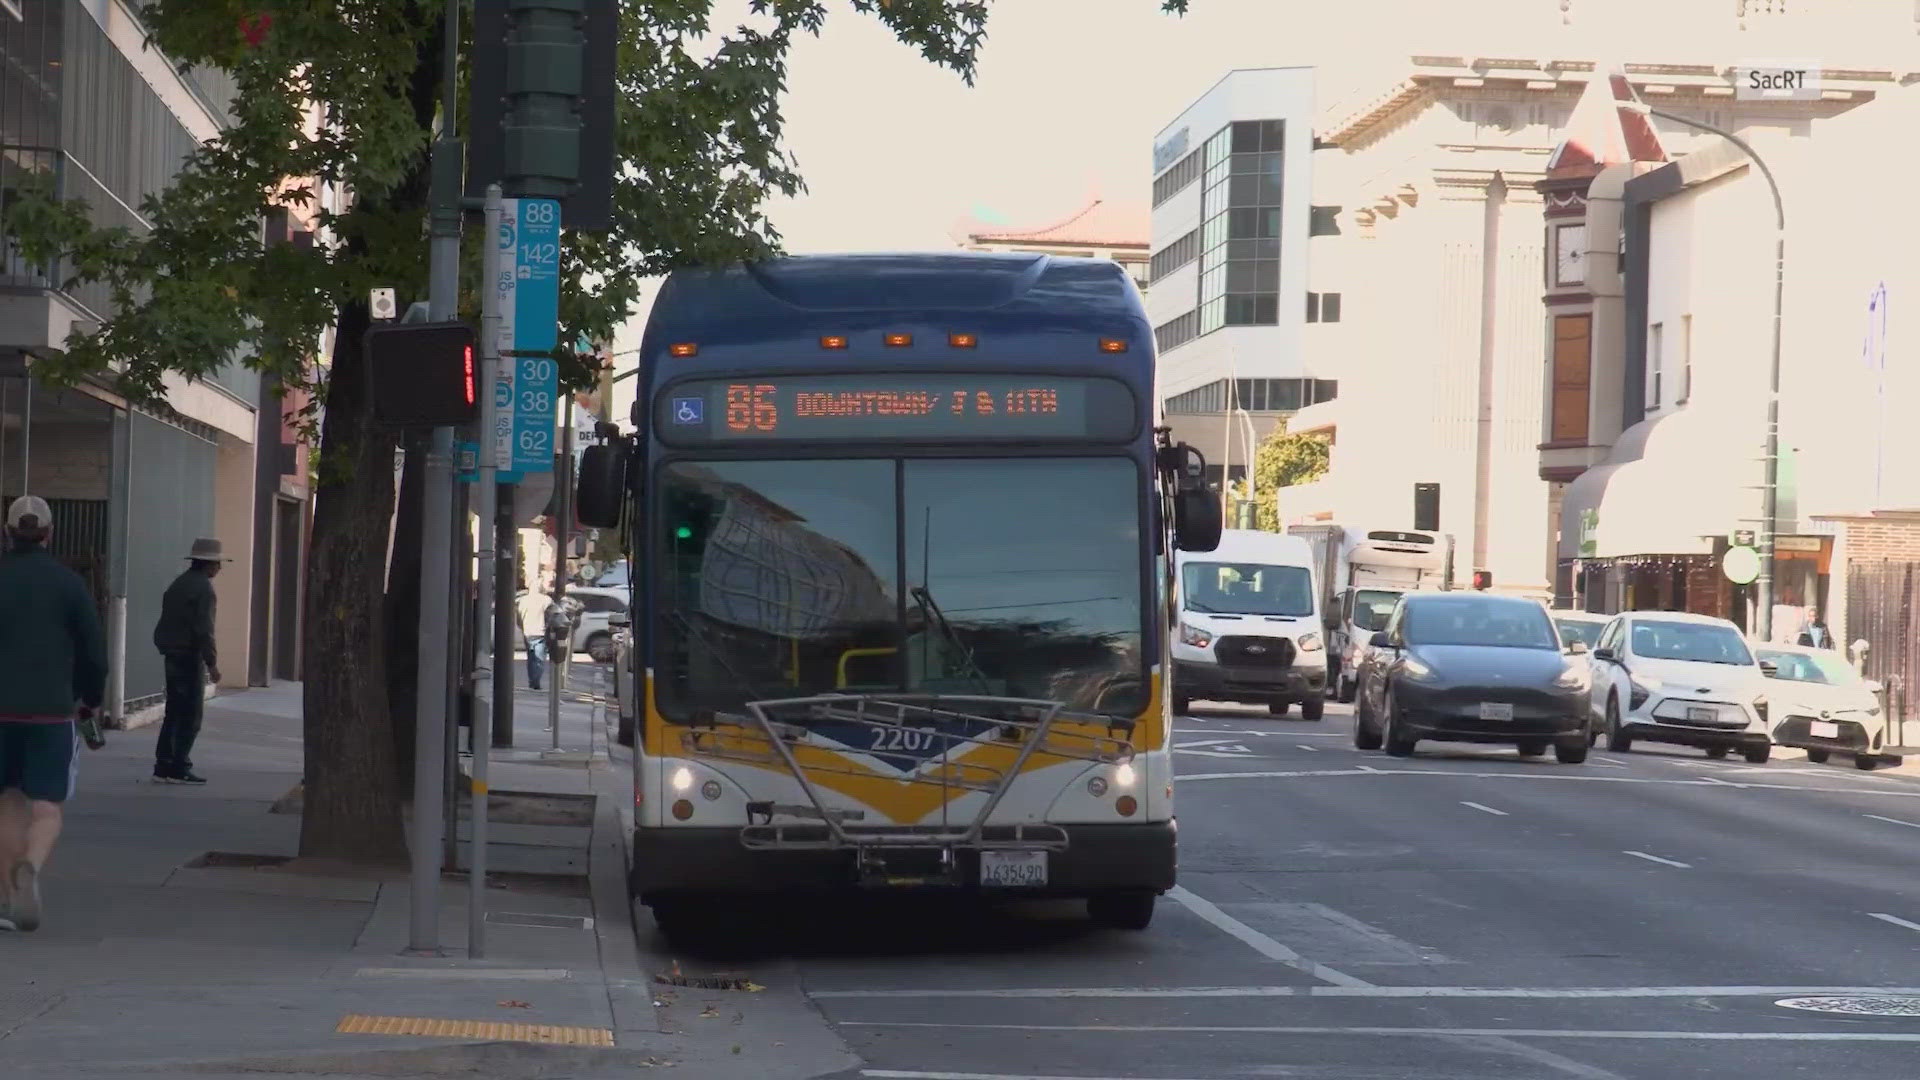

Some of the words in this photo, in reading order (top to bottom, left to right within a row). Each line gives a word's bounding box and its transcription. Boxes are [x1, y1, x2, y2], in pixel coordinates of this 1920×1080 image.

[525, 203, 553, 223] 88
[520, 243, 555, 263] 142
[523, 360, 550, 381] 30
[521, 391, 549, 412] 38
[728, 384, 777, 431] 86
[520, 430, 547, 450] 62
[871, 727, 936, 750] 2207
